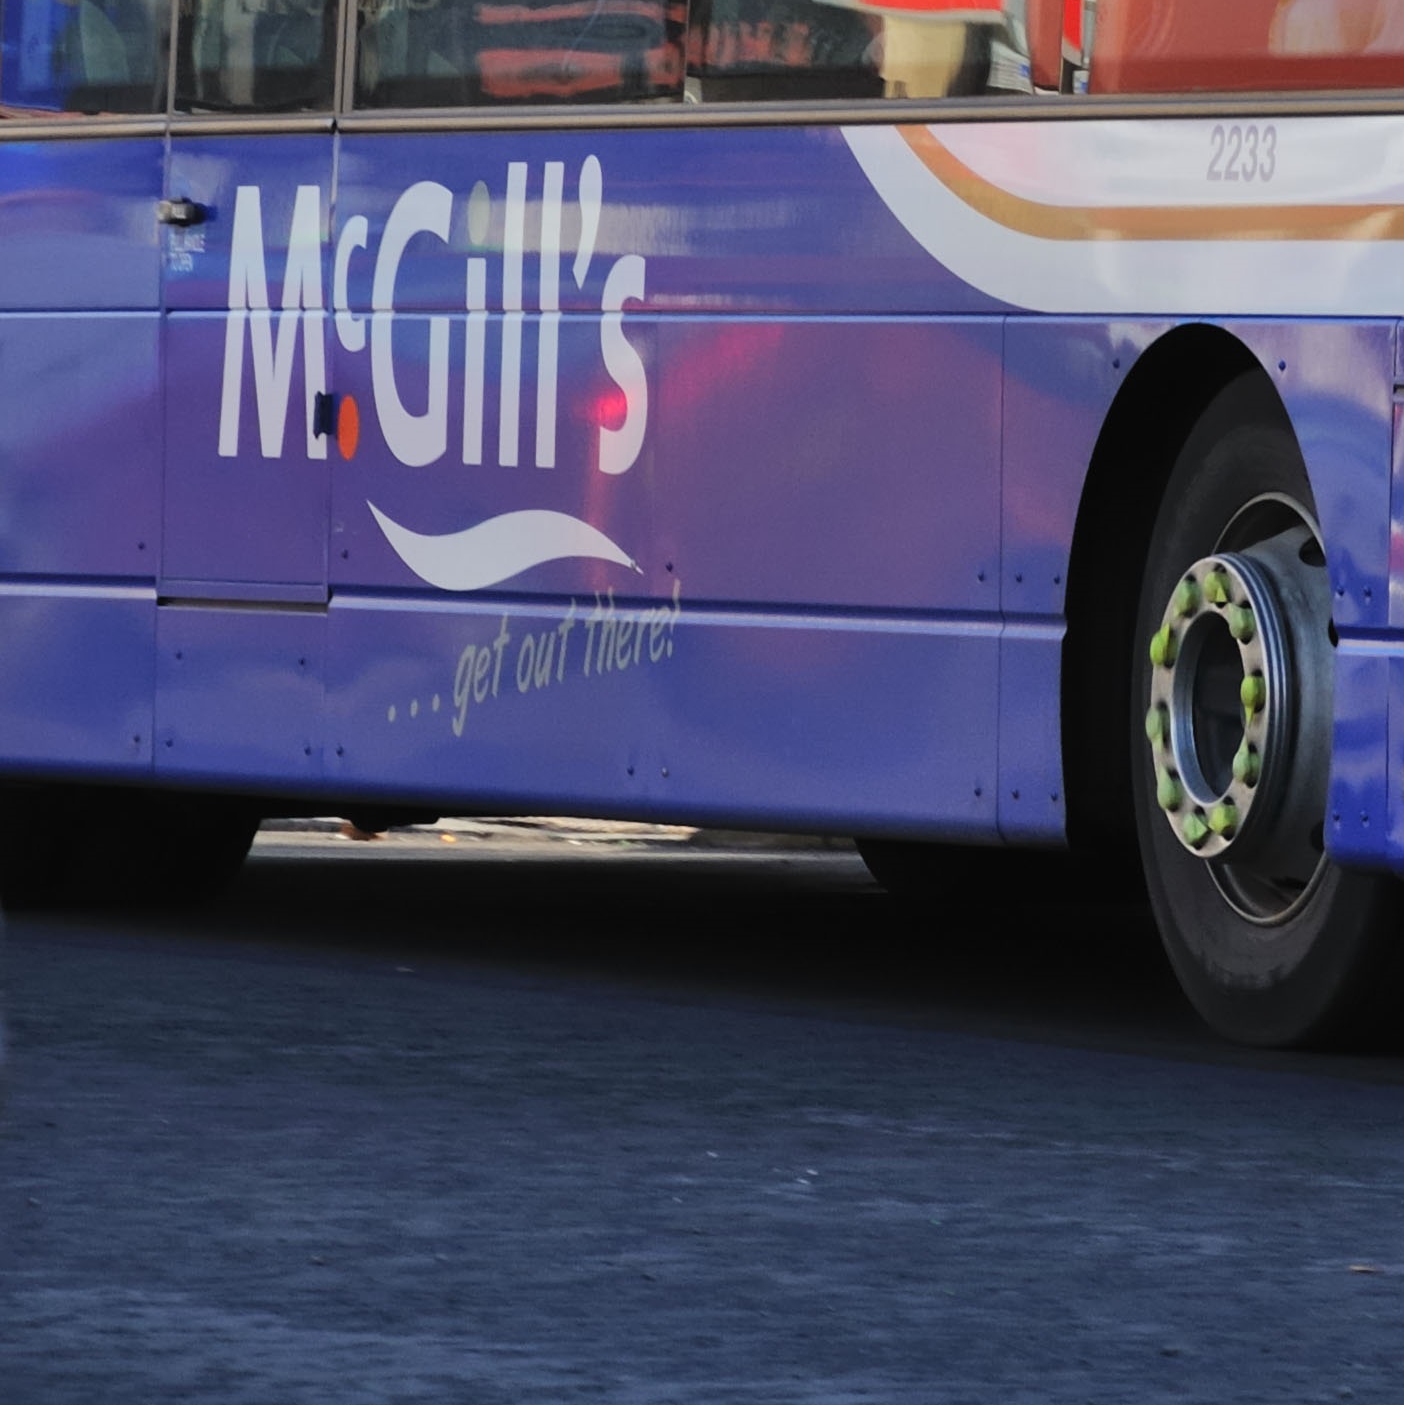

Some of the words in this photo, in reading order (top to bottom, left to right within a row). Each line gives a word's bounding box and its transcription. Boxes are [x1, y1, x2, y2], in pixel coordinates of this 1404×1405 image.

[1206, 123, 1277, 182] 2233
[218, 154, 648, 476] McGill's
[516, 597, 576, 693] out
[583, 578, 681, 677] there!
